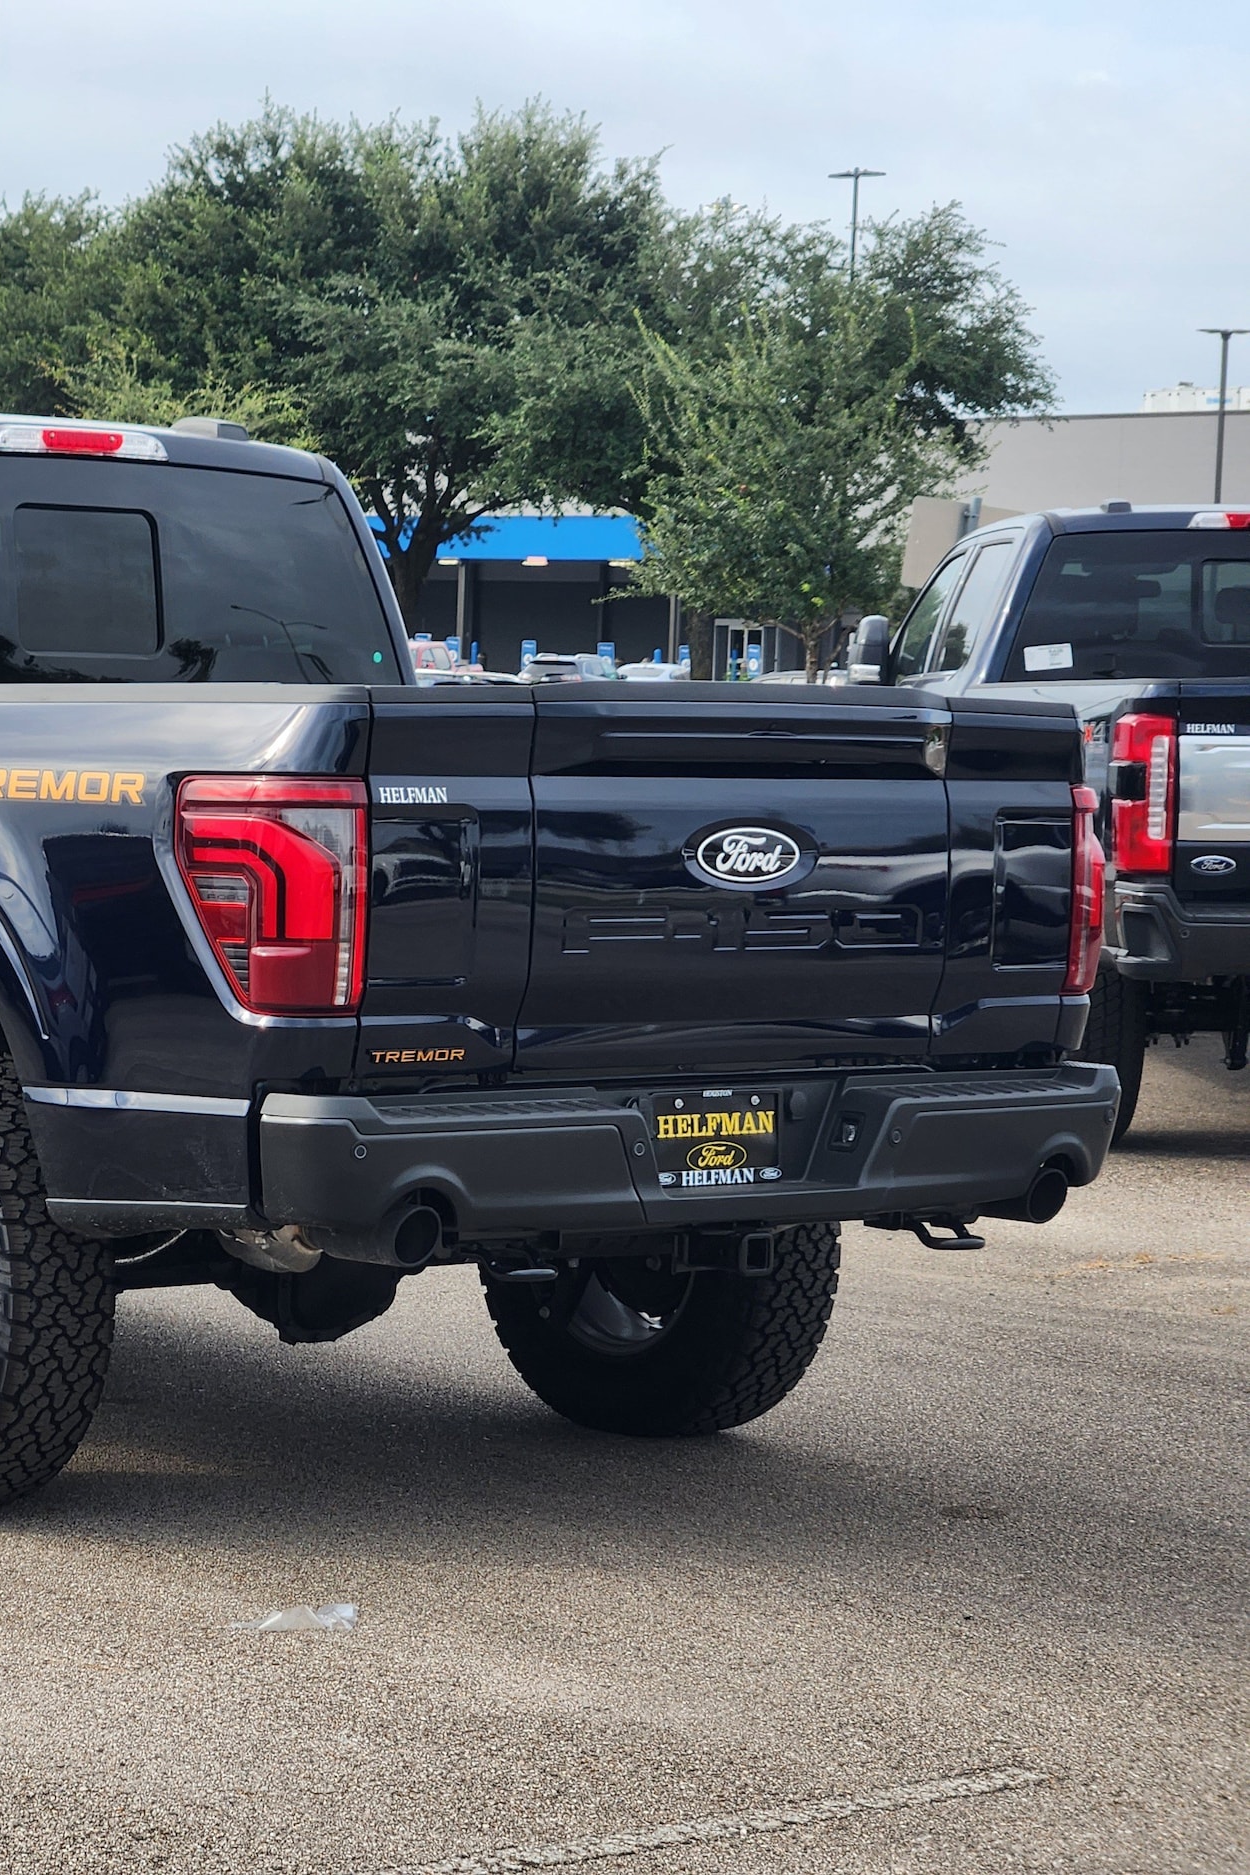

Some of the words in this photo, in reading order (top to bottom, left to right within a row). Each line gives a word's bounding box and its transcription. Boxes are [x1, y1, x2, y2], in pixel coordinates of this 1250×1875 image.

[1186, 723, 1236, 734] HELFMAN
[378, 786, 448, 804] HELFMAN
[715, 834, 783, 873] Ford
[1201, 859, 1227, 870] Ford
[561, 905, 924, 954] F-150
[371, 1048, 466, 1063] TREMOR
[657, 1111, 775, 1138] HELFMAN
[698, 1144, 736, 1168] Ford
[681, 1167, 755, 1187] HELFMAN
